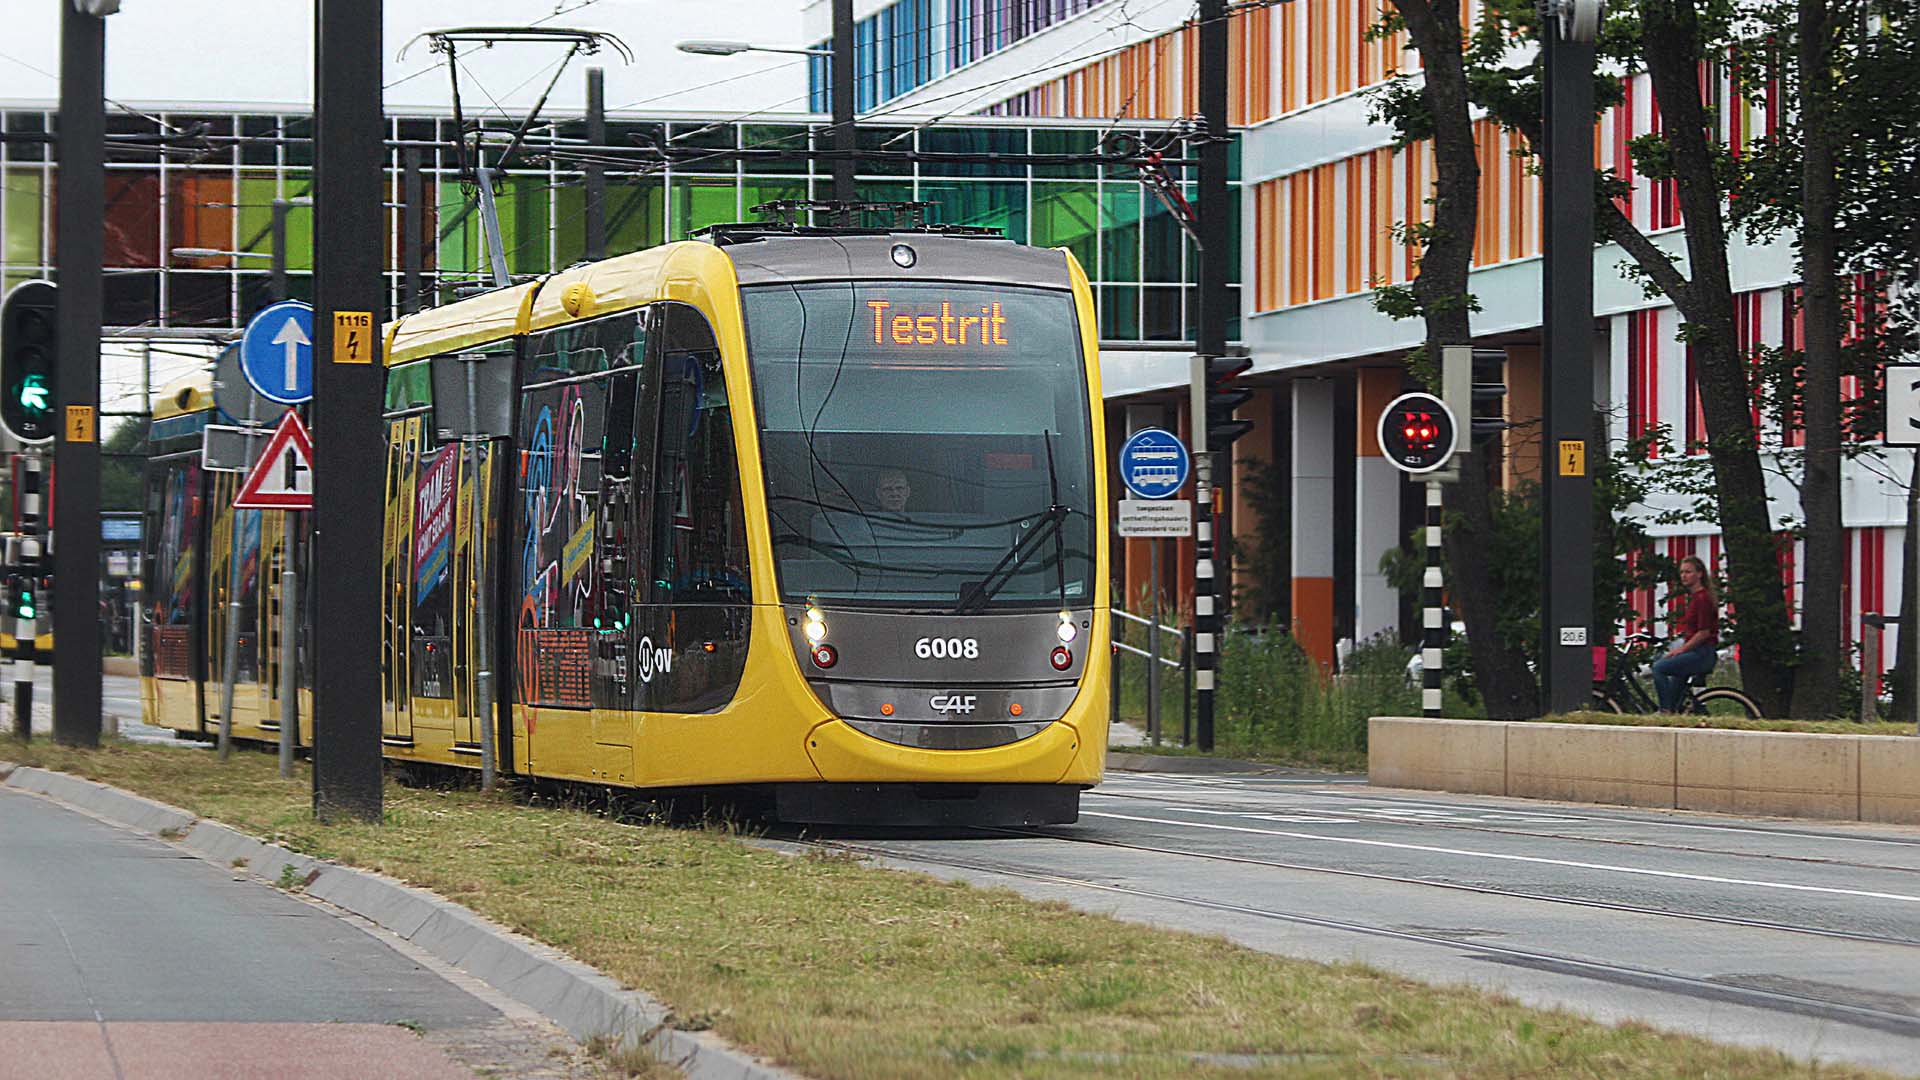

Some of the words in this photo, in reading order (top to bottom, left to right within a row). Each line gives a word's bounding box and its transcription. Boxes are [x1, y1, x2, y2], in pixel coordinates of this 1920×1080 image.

[337, 315, 369, 327] 1116
[867, 299, 1008, 345] Testrit
[418, 461, 446, 530] TRAM
[915, 637, 979, 659] 6008
[930, 695, 977, 714] CAF
